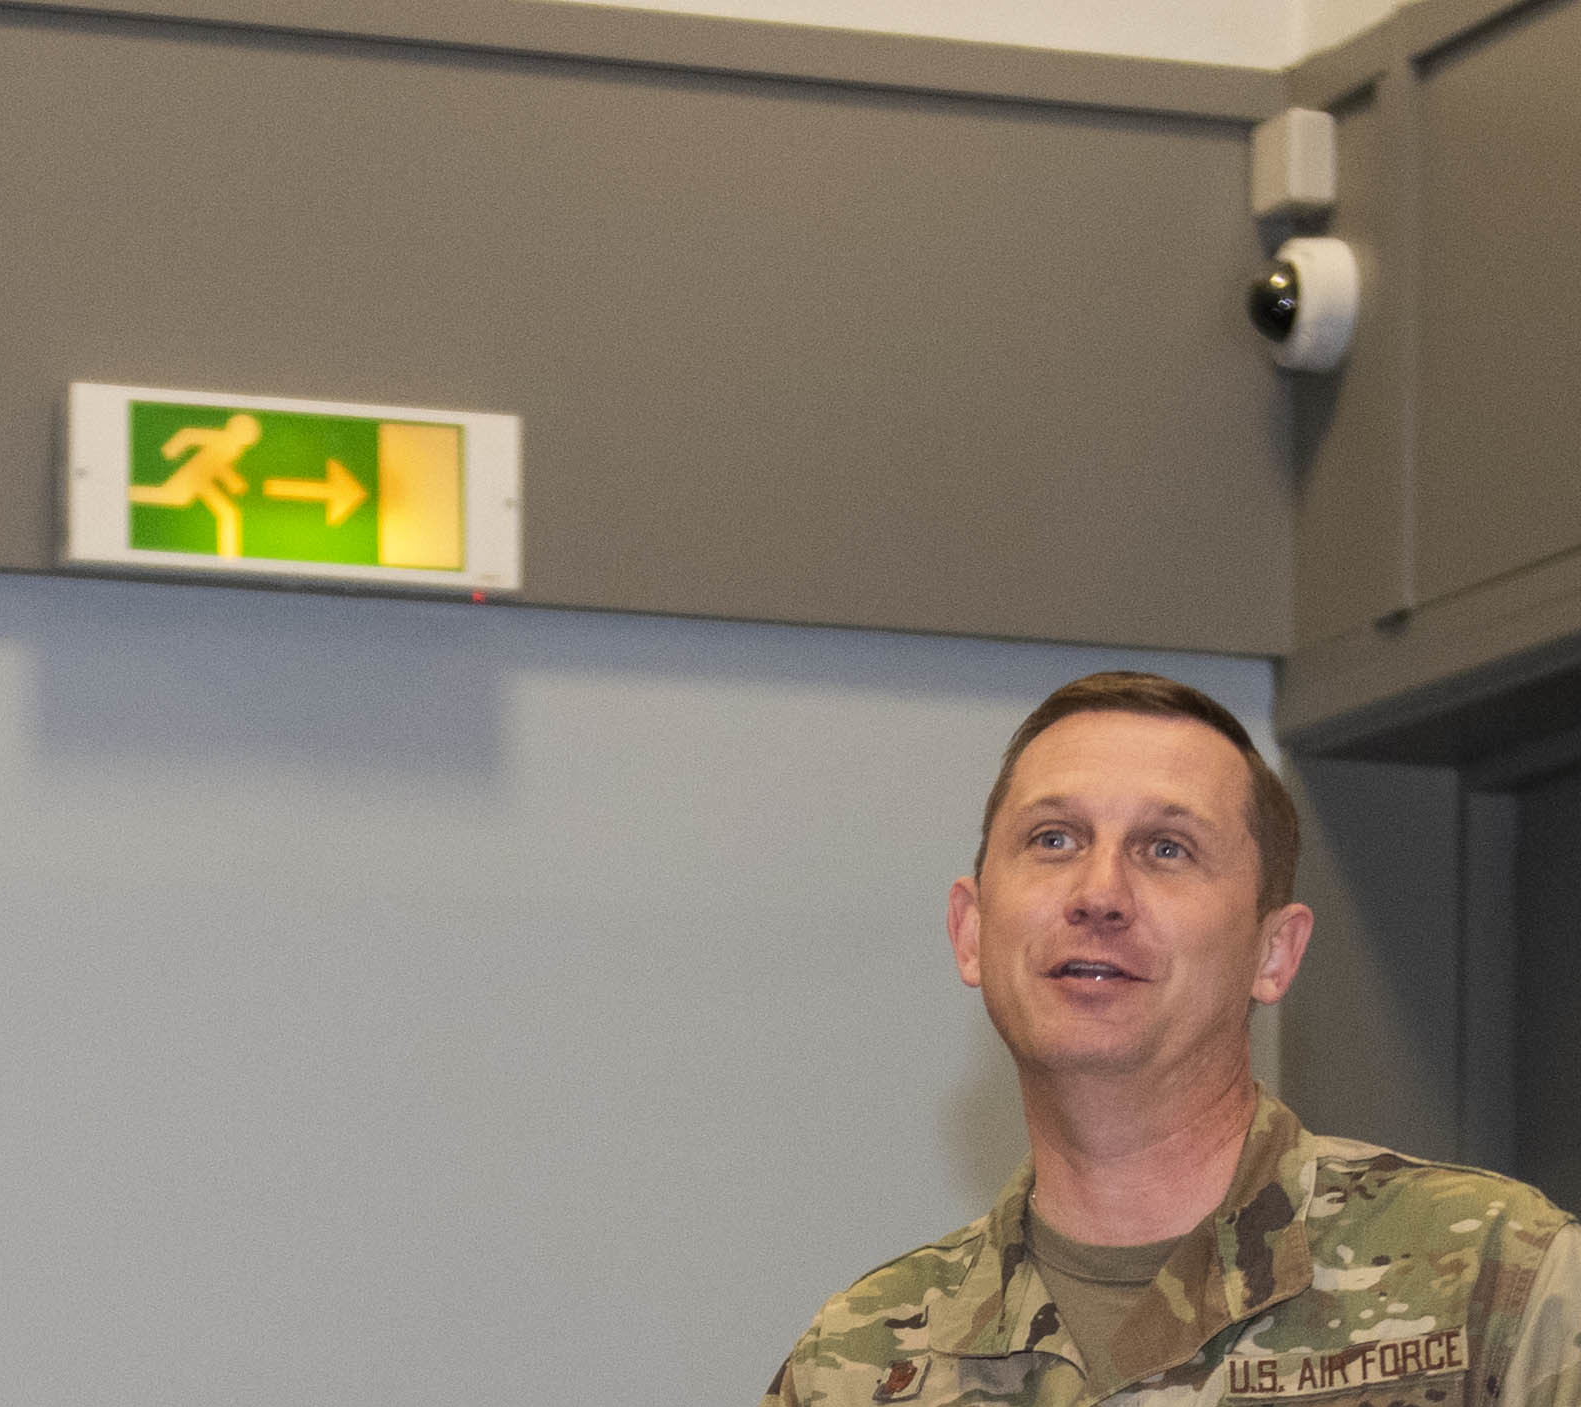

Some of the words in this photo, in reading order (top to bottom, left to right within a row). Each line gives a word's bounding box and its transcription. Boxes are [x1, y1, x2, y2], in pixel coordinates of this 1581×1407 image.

[1229, 1359, 1285, 1394] U.S.
[1297, 1354, 1350, 1391] AIR
[1359, 1327, 1463, 1380] FORCE
